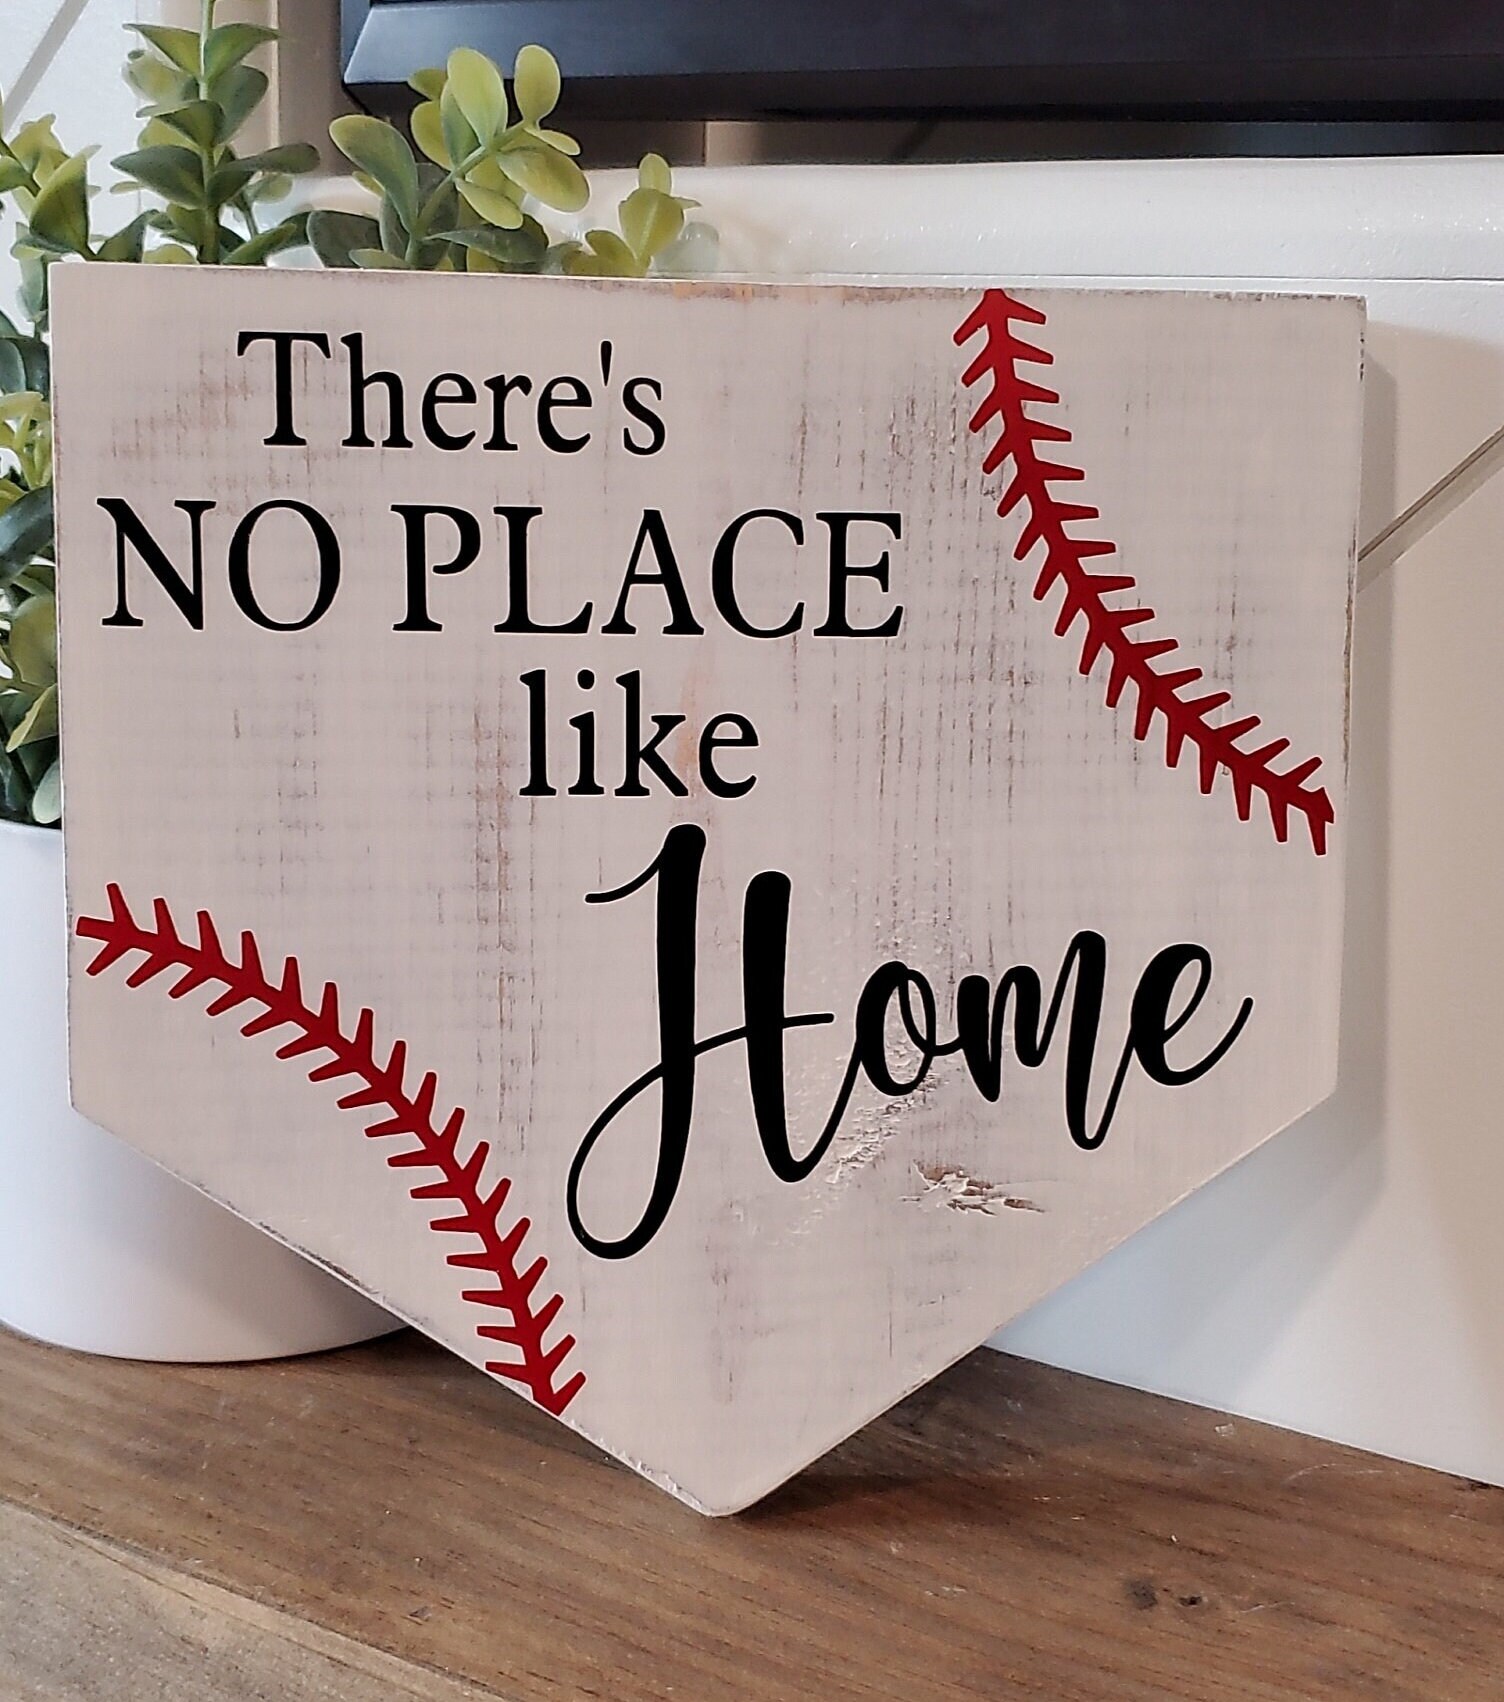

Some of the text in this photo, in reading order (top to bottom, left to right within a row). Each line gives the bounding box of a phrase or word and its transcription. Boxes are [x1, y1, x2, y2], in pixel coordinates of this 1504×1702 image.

[238, 331, 666, 456] There's
[97, 498, 904, 639] NO PLACE
[519, 669, 759, 799] like
[567, 823, 1254, 1260] Home
